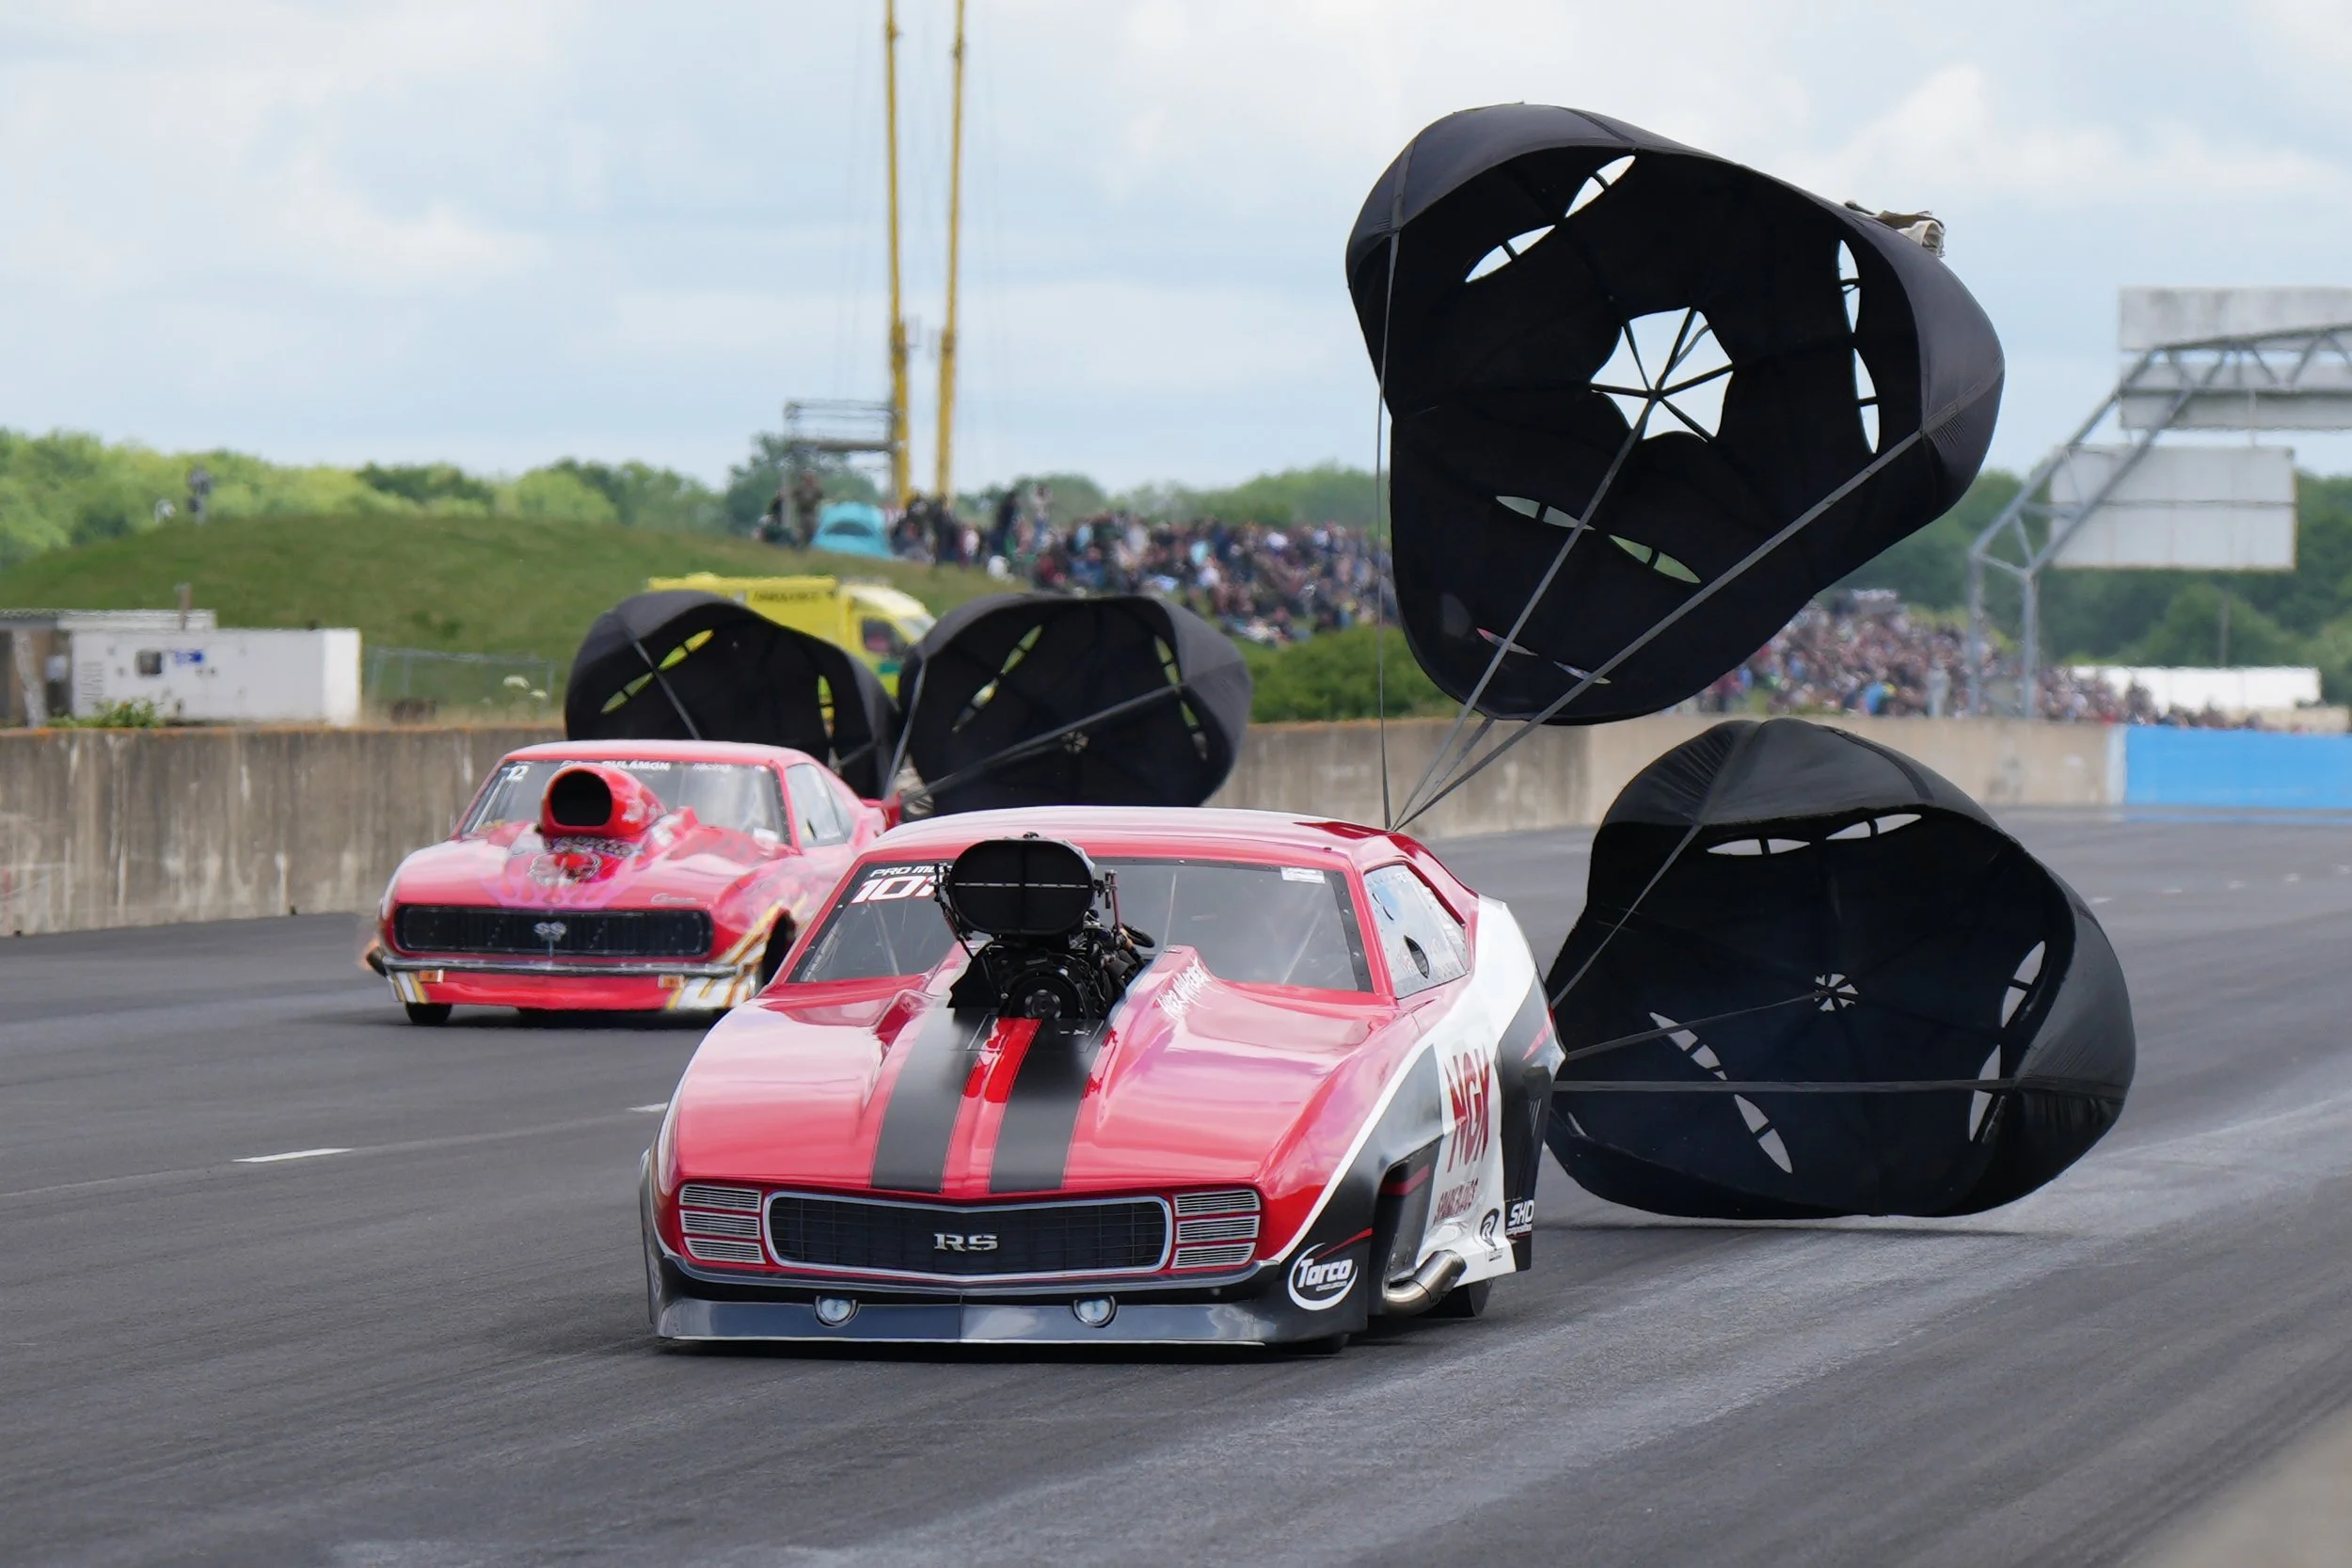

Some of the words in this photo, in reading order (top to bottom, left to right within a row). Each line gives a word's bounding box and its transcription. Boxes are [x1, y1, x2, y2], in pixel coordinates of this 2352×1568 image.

[869, 866, 913, 878] PRO
[912, 863, 953, 875] MO
[933, 1233, 998, 1252] RS
[1297, 1258, 1353, 1289] Torco
